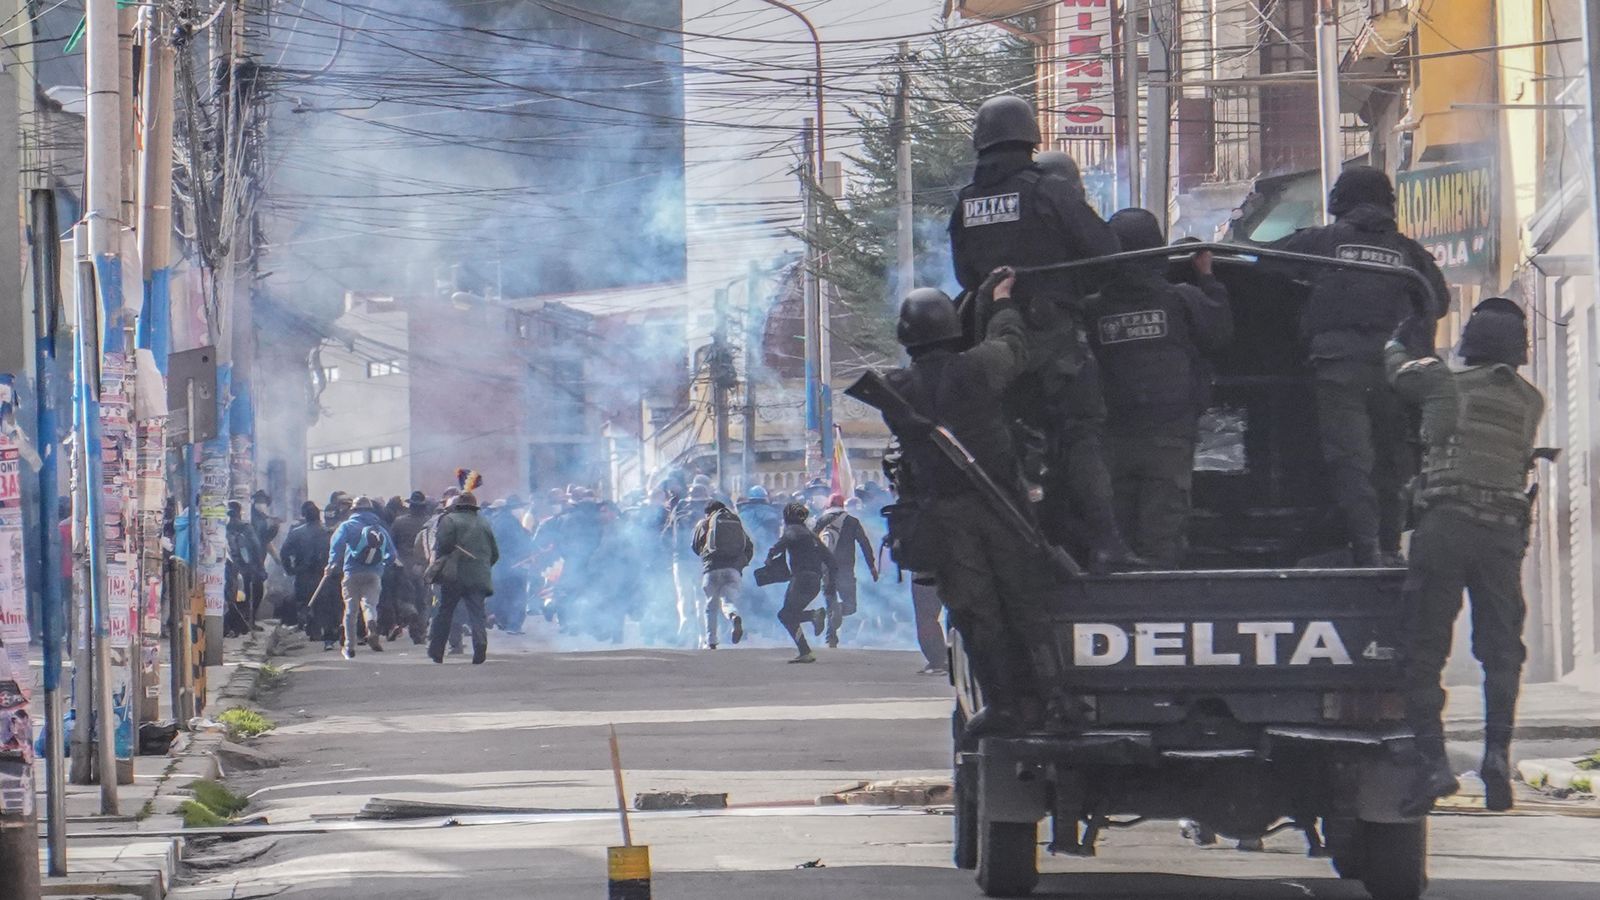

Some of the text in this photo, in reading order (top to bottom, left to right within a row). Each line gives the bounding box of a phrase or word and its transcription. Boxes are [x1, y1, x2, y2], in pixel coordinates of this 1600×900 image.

[965, 197, 1006, 218] DELTA
[1398, 168, 1490, 240] ALOJAMIENTO
[1074, 621, 1353, 666] DELTA
